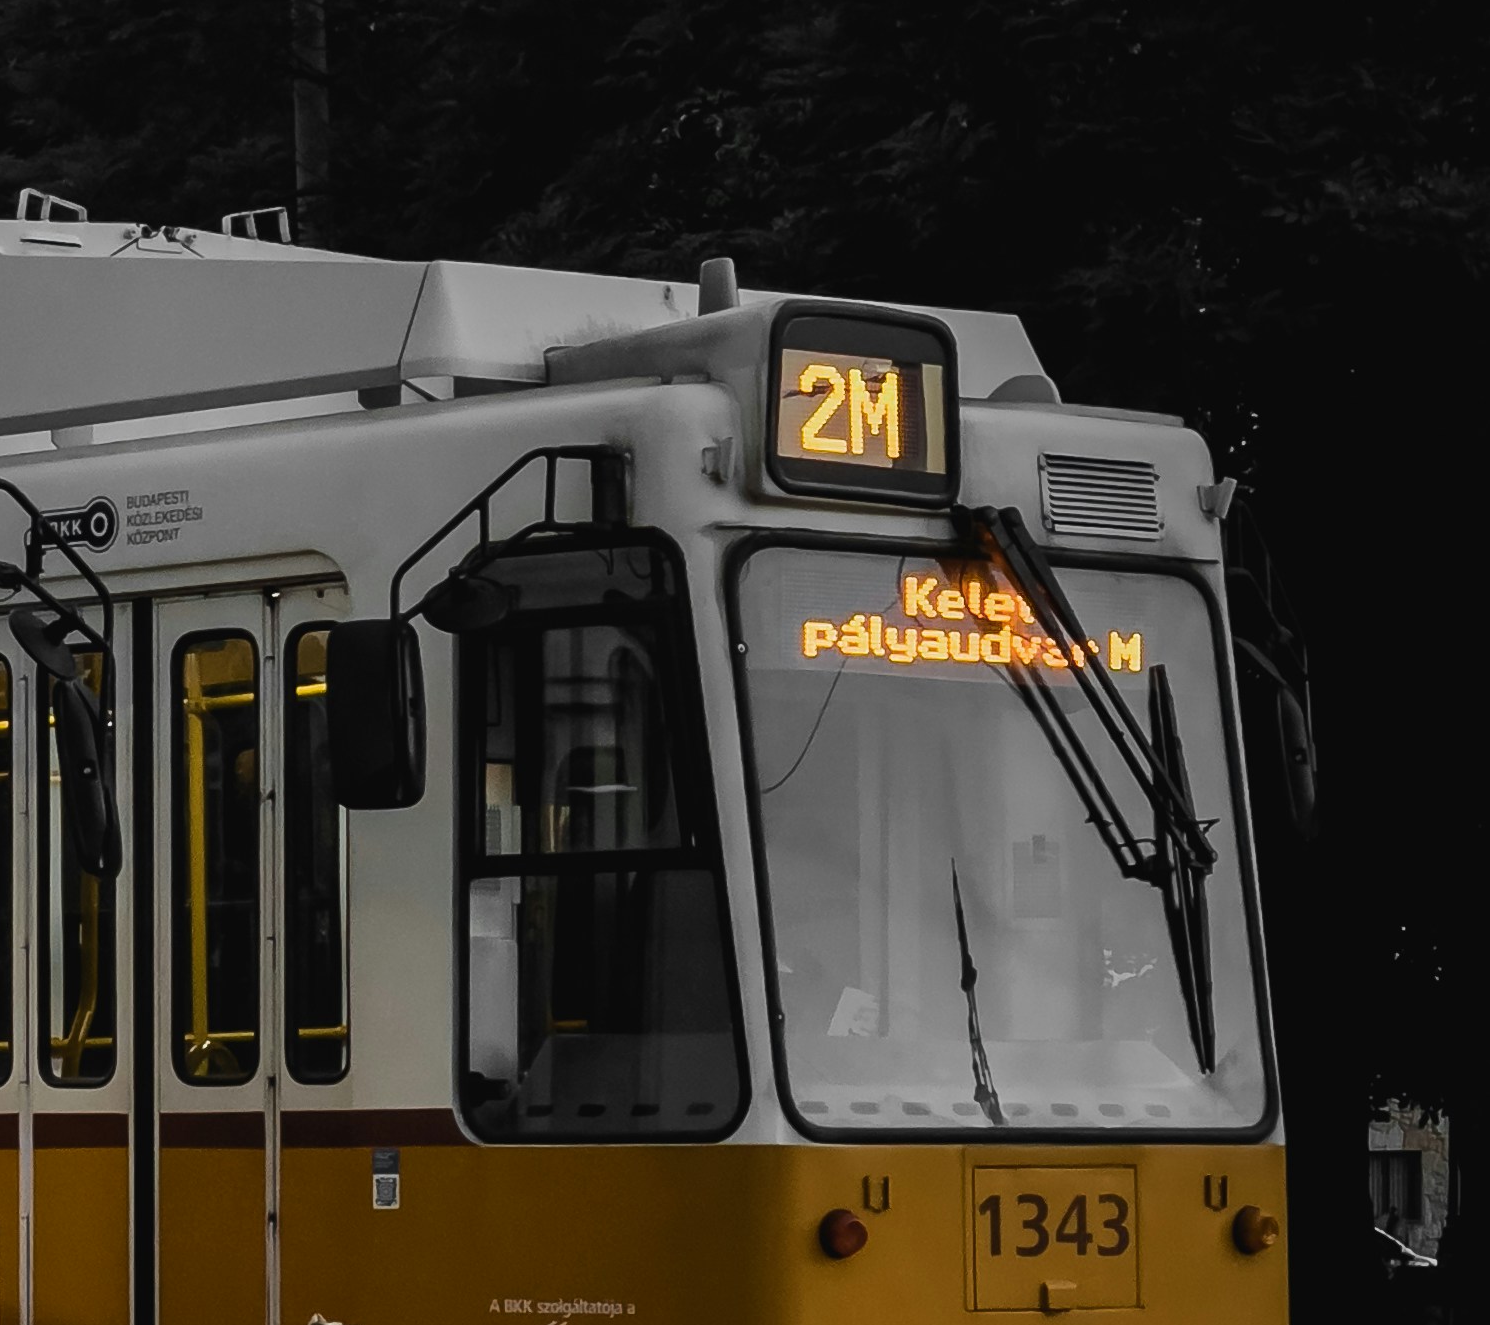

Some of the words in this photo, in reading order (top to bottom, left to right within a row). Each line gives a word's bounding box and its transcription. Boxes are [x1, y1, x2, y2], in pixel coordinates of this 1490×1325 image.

[798, 363, 901, 460] 2M
[126, 490, 189, 509] BUDAPESTI
[126, 507, 203, 527] KÖZLEKEDÉSI
[126, 527, 180, 545] KÖZPONT
[1108, 630, 1142, 673] M
[978, 1193, 1130, 1256] 1343
[489, 1298, 500, 1313] A
[504, 1298, 533, 1313] BKK
[626, 1303, 636, 1315] a
